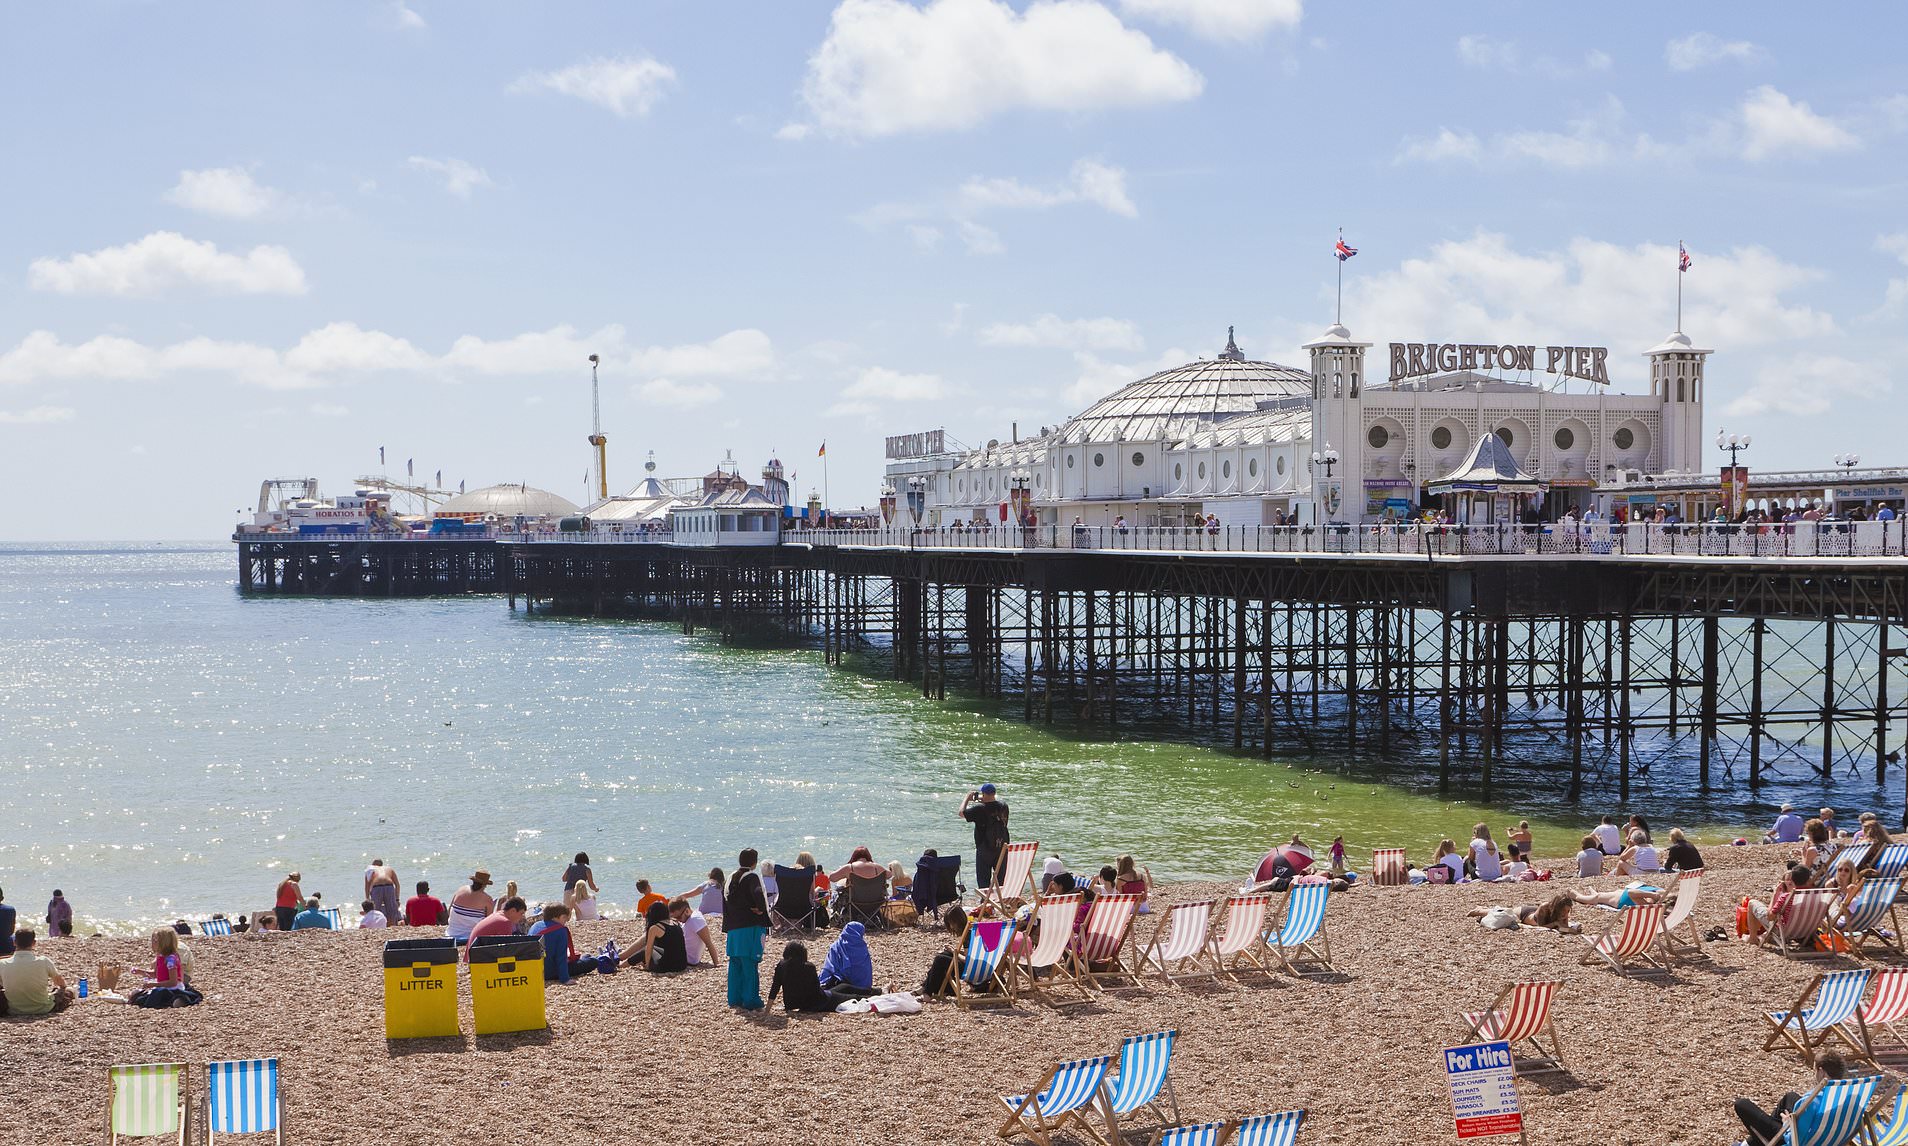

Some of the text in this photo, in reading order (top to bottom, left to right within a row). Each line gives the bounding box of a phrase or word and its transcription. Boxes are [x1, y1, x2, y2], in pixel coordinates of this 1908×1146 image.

[1389, 342, 1610, 386] BRIGHTON PIER
[885, 429, 944, 458] BRIGHTON PIER
[1853, 487, 1885, 496] Shellfish
[1888, 487, 1902, 495] Bar
[400, 980, 443, 991] LITTER
[486, 976, 528, 989] LITTER
[1447, 1046, 1509, 1071] For Hire
